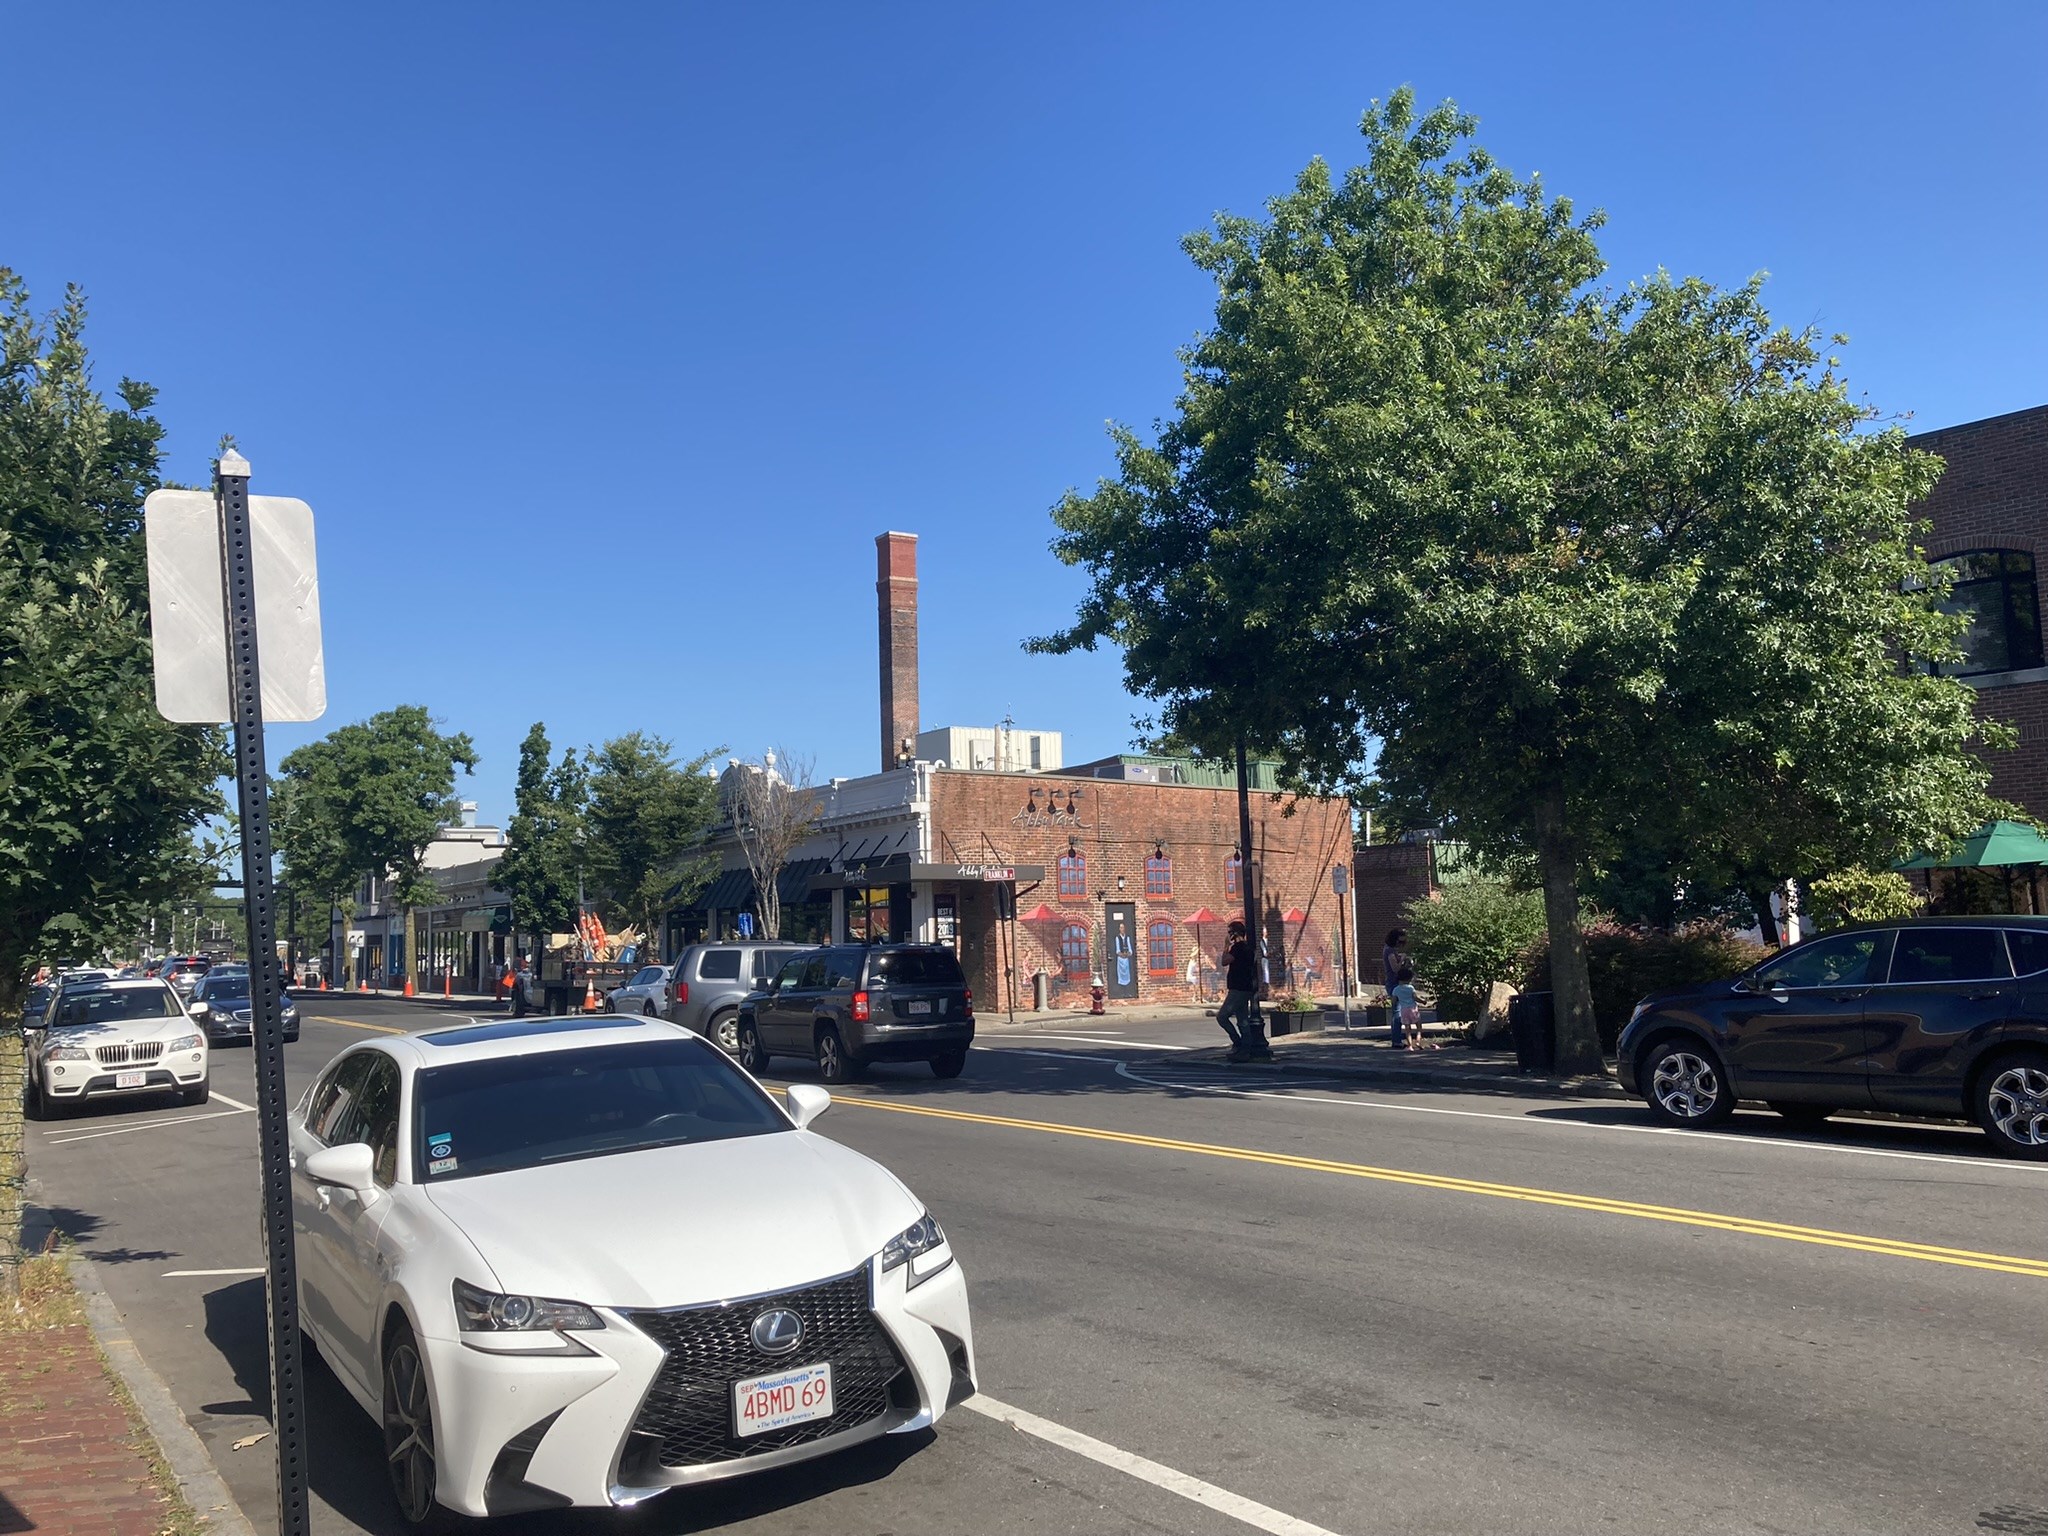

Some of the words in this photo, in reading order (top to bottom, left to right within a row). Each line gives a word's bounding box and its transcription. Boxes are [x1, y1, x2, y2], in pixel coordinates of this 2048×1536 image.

[1011, 806, 1048, 832] Abby
[1049, 807, 1092, 829] Park
[957, 865, 979, 879] Abby
[985, 869, 1008, 879] FRANKLIN
[937, 924, 954, 936] 2019
[740, 1385, 754, 1394] SEP
[757, 1373, 810, 1391] Massachusetts
[744, 1385, 795, 1420] 4BMD
[802, 1378, 826, 1407] 69
[771, 1417, 785, 1427] Spirit
[791, 1412, 811, 1421] America
